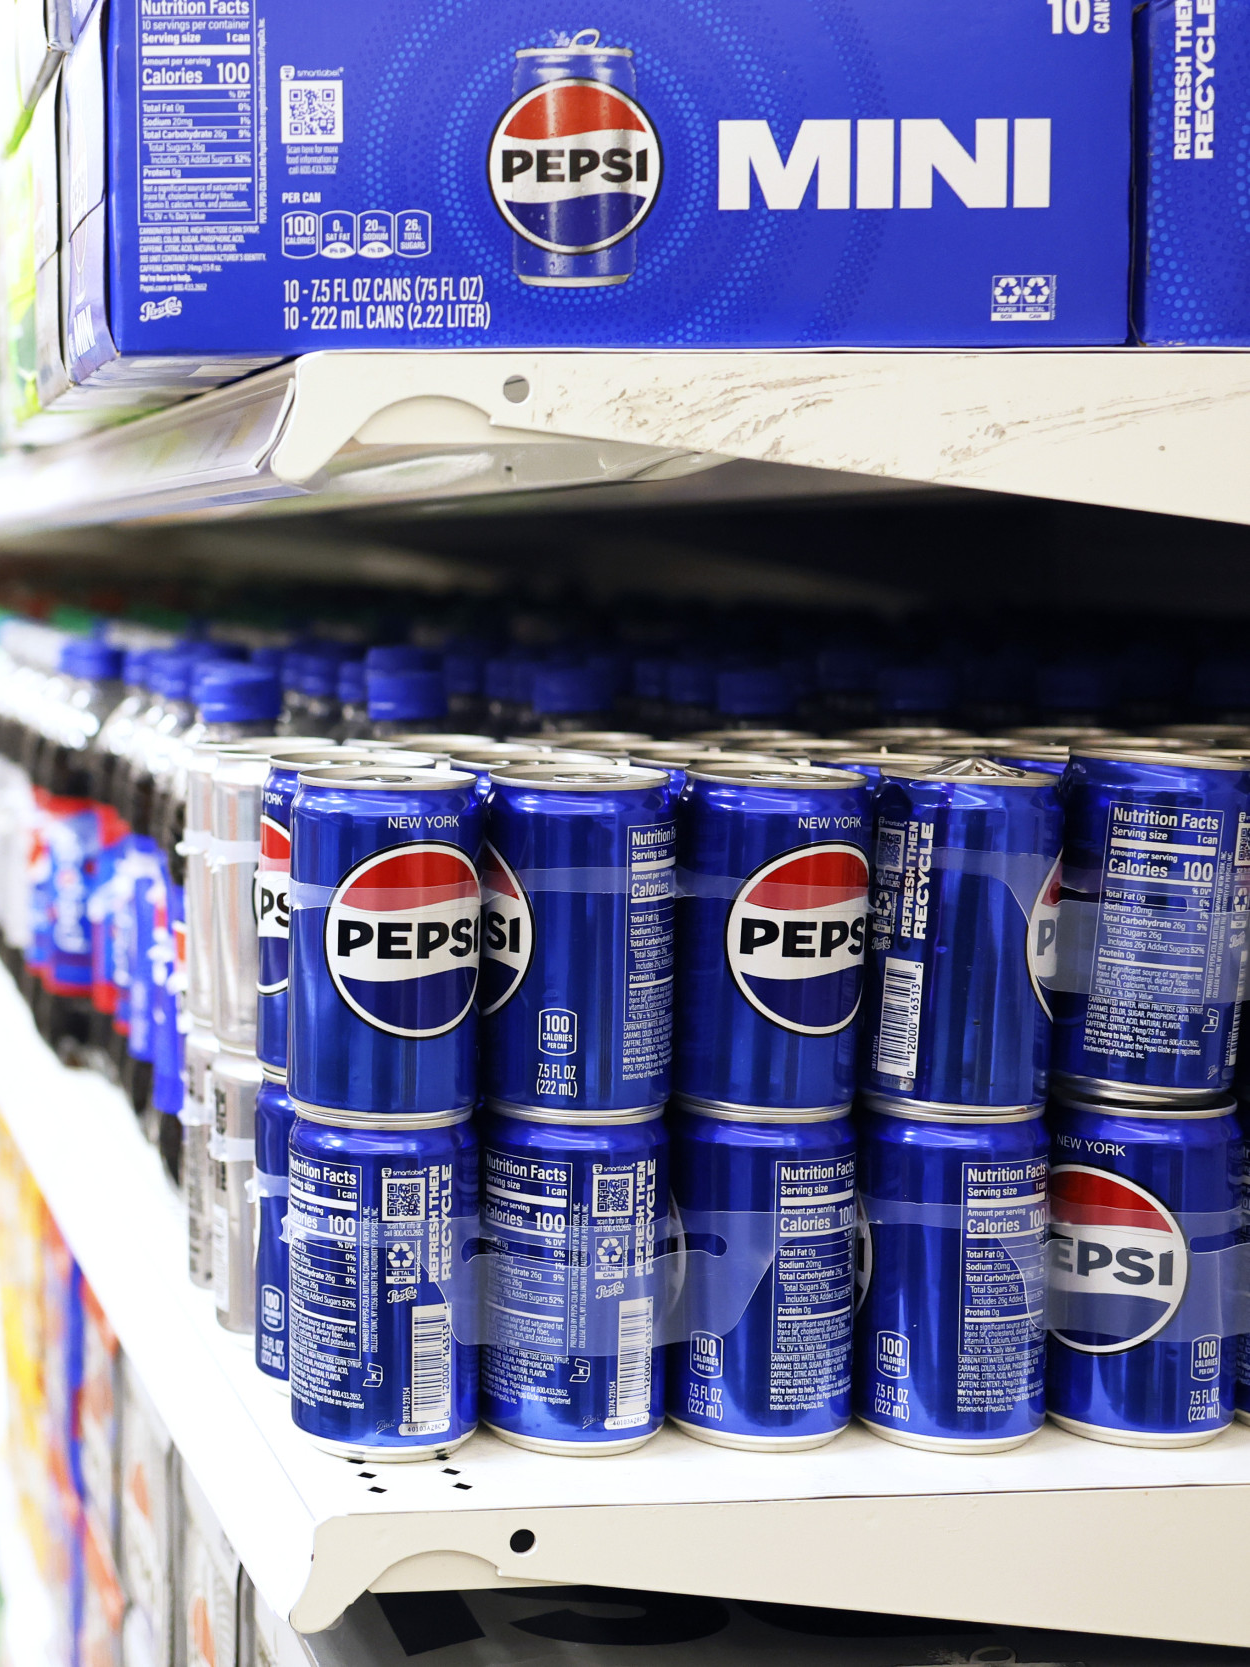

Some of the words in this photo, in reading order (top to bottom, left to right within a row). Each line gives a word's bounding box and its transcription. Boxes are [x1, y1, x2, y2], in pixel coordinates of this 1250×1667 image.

[142, 0, 206, 15] Nutrition
[210, 0, 249, 14] Facts
[1047, 0, 1091, 35] 10
[1093, 0, 1110, 34] CAN
[142, 21, 150, 30] 10
[153, 20, 190, 32] servings
[192, 21, 206, 32] per
[208, 20, 249, 30] container
[1175, 0, 1192, 52] THE
[142, 33, 179, 44] Serving
[181, 33, 201, 43] size
[226, 33, 230, 42] 1
[232, 33, 250, 42] can
[142, 68, 203, 84] Calories
[217, 62, 250, 83] 100
[1174, 56, 1192, 160] REFRESH
[501, 148, 648, 182] PEPSI
[718, 118, 1051, 210] MINI
[282, 192, 300, 203] PER
[303, 192, 321, 203] CAN
[286, 216, 315, 236] 100
[286, 237, 315, 245] CALORIES
[283, 279, 299, 303] 10
[311, 279, 330, 302] 7.5
[334, 278, 348, 302] FL
[353, 278, 370, 302] OZ
[374, 278, 411, 301] CANS
[415, 276, 437, 303] (75
[441, 277, 456, 300] FL
[460, 275, 483, 303] OZ)
[283, 307, 299, 329] 10
[311, 306, 337, 329] 222
[341, 305, 363, 329] mL
[367, 305, 404, 329] CANS
[408, 303, 443, 330] (2.22
[448, 302, 490, 330] LITER)
[265, 792, 282, 806] YORK
[388, 816, 421, 828] NEW
[426, 816, 459, 828] YORK
[798, 817, 830, 829] NEW
[834, 816, 861, 828] YORK
[1114, 807, 1177, 827] Nutrition
[1182, 814, 1218, 830] Facts
[632, 829, 670, 845] Nutrition
[907, 821, 918, 863] THEN
[1112, 827, 1146, 840] Serving
[1149, 831, 1168, 840] size
[1197, 835, 1201, 843] 1
[1202, 835, 1217, 844] can
[632, 850, 657, 860] Serving
[658, 848, 667, 857] size
[1111, 849, 1136, 858] Amount
[1138, 852, 1149, 860] per
[1151, 852, 1177, 863] serving
[1109, 858, 1168, 877] Calories
[1183, 862, 1213, 881] 100
[632, 880, 668, 897] Calories
[914, 822, 934, 940] RECYCLE
[901, 866, 915, 938] REFRESH
[1104, 902, 1130, 912] Sodium
[1132, 906, 1152, 916] 20mg
[1121, 915, 1171, 928] Carbohydrate
[1173, 922, 1185, 931] 26g
[337, 917, 478, 959] PEPSI
[740, 917, 864, 957] PEPS
[1099, 948, 1124, 959] Protein
[1126, 952, 1135, 960] 0g
[910, 984, 920, 1016] 16313
[545, 1015, 569, 1033] 100
[543, 1033, 572, 1042] CALORIES
[907, 1023, 917, 1055] 12000
[538, 1063, 549, 1077] 7.5
[552, 1064, 562, 1079] FL
[564, 1065, 576, 1079] OZ
[536, 1079, 556, 1095] (222
[559, 1081, 577, 1098] mL)
[1057, 1134, 1081, 1149] NEW
[1085, 1140, 1126, 1157] YORK
[323, 1167, 357, 1185] Facts
[487, 1154, 527, 1177] Nutrition
[530, 1164, 567, 1182] Facts
[781, 1165, 834, 1180] Nutrition
[837, 1160, 854, 1176] Facts
[967, 1167, 1023, 1182] Nutrition
[1026, 1163, 1046, 1179] Facts
[304, 1181, 315, 1192] size
[337, 1189, 340, 1197] 1
[342, 1191, 357, 1199] can
[429, 1166, 439, 1209] THEN
[507, 1180, 520, 1189] size
[546, 1186, 549, 1194] 1
[551, 1188, 567, 1196] can
[636, 1161, 646, 1203] THEN
[781, 1185, 812, 1196] Serving
[814, 1184, 828, 1193] size
[967, 1187, 1000, 1198] Serving
[1003, 1187, 1017, 1195] size
[328, 1215, 356, 1236] 100
[441, 1164, 452, 1281] RECYCLE
[486, 1204, 523, 1226] Calories
[535, 1212, 565, 1232] 100
[646, 1159, 656, 1275] RECYCLE
[780, 1216, 830, 1231] Calories
[839, 1205, 853, 1226] 100
[967, 1218, 1019, 1233] Calories
[1029, 1208, 1045, 1228] 100
[429, 1211, 439, 1282] REFRESH
[635, 1205, 645, 1277] REFRESH
[806, 1261, 821, 1269] 20mg
[994, 1263, 1010, 1271] 20mg
[1052, 1240, 1173, 1286] EPSI
[696, 1337, 716, 1356] 100
[882, 1337, 903, 1356] 100
[1198, 1341, 1216, 1359] 100
[693, 1353, 719, 1366] CALORIES
[880, 1354, 905, 1366] CALORIES
[1195, 1358, 1218, 1368] CALORIES
[690, 1383, 698, 1398] 7.5
[701, 1385, 709, 1401] FL
[711, 1388, 722, 1403] OZ
[876, 1382, 885, 1398] 7.5
[887, 1386, 896, 1401] FL
[898, 1388, 908, 1404] OZ
[1190, 1391, 1200, 1405] 7.5
[1202, 1390, 1210, 1404] FL
[1211, 1387, 1219, 1402] OZ
[688, 1397, 704, 1415] (222
[706, 1404, 723, 1421] mL)
[875, 1397, 891, 1415] (222
[893, 1404, 909, 1422] mL)
[1188, 1406, 1205, 1423] (222
[1207, 1402, 1219, 1419] mL)
